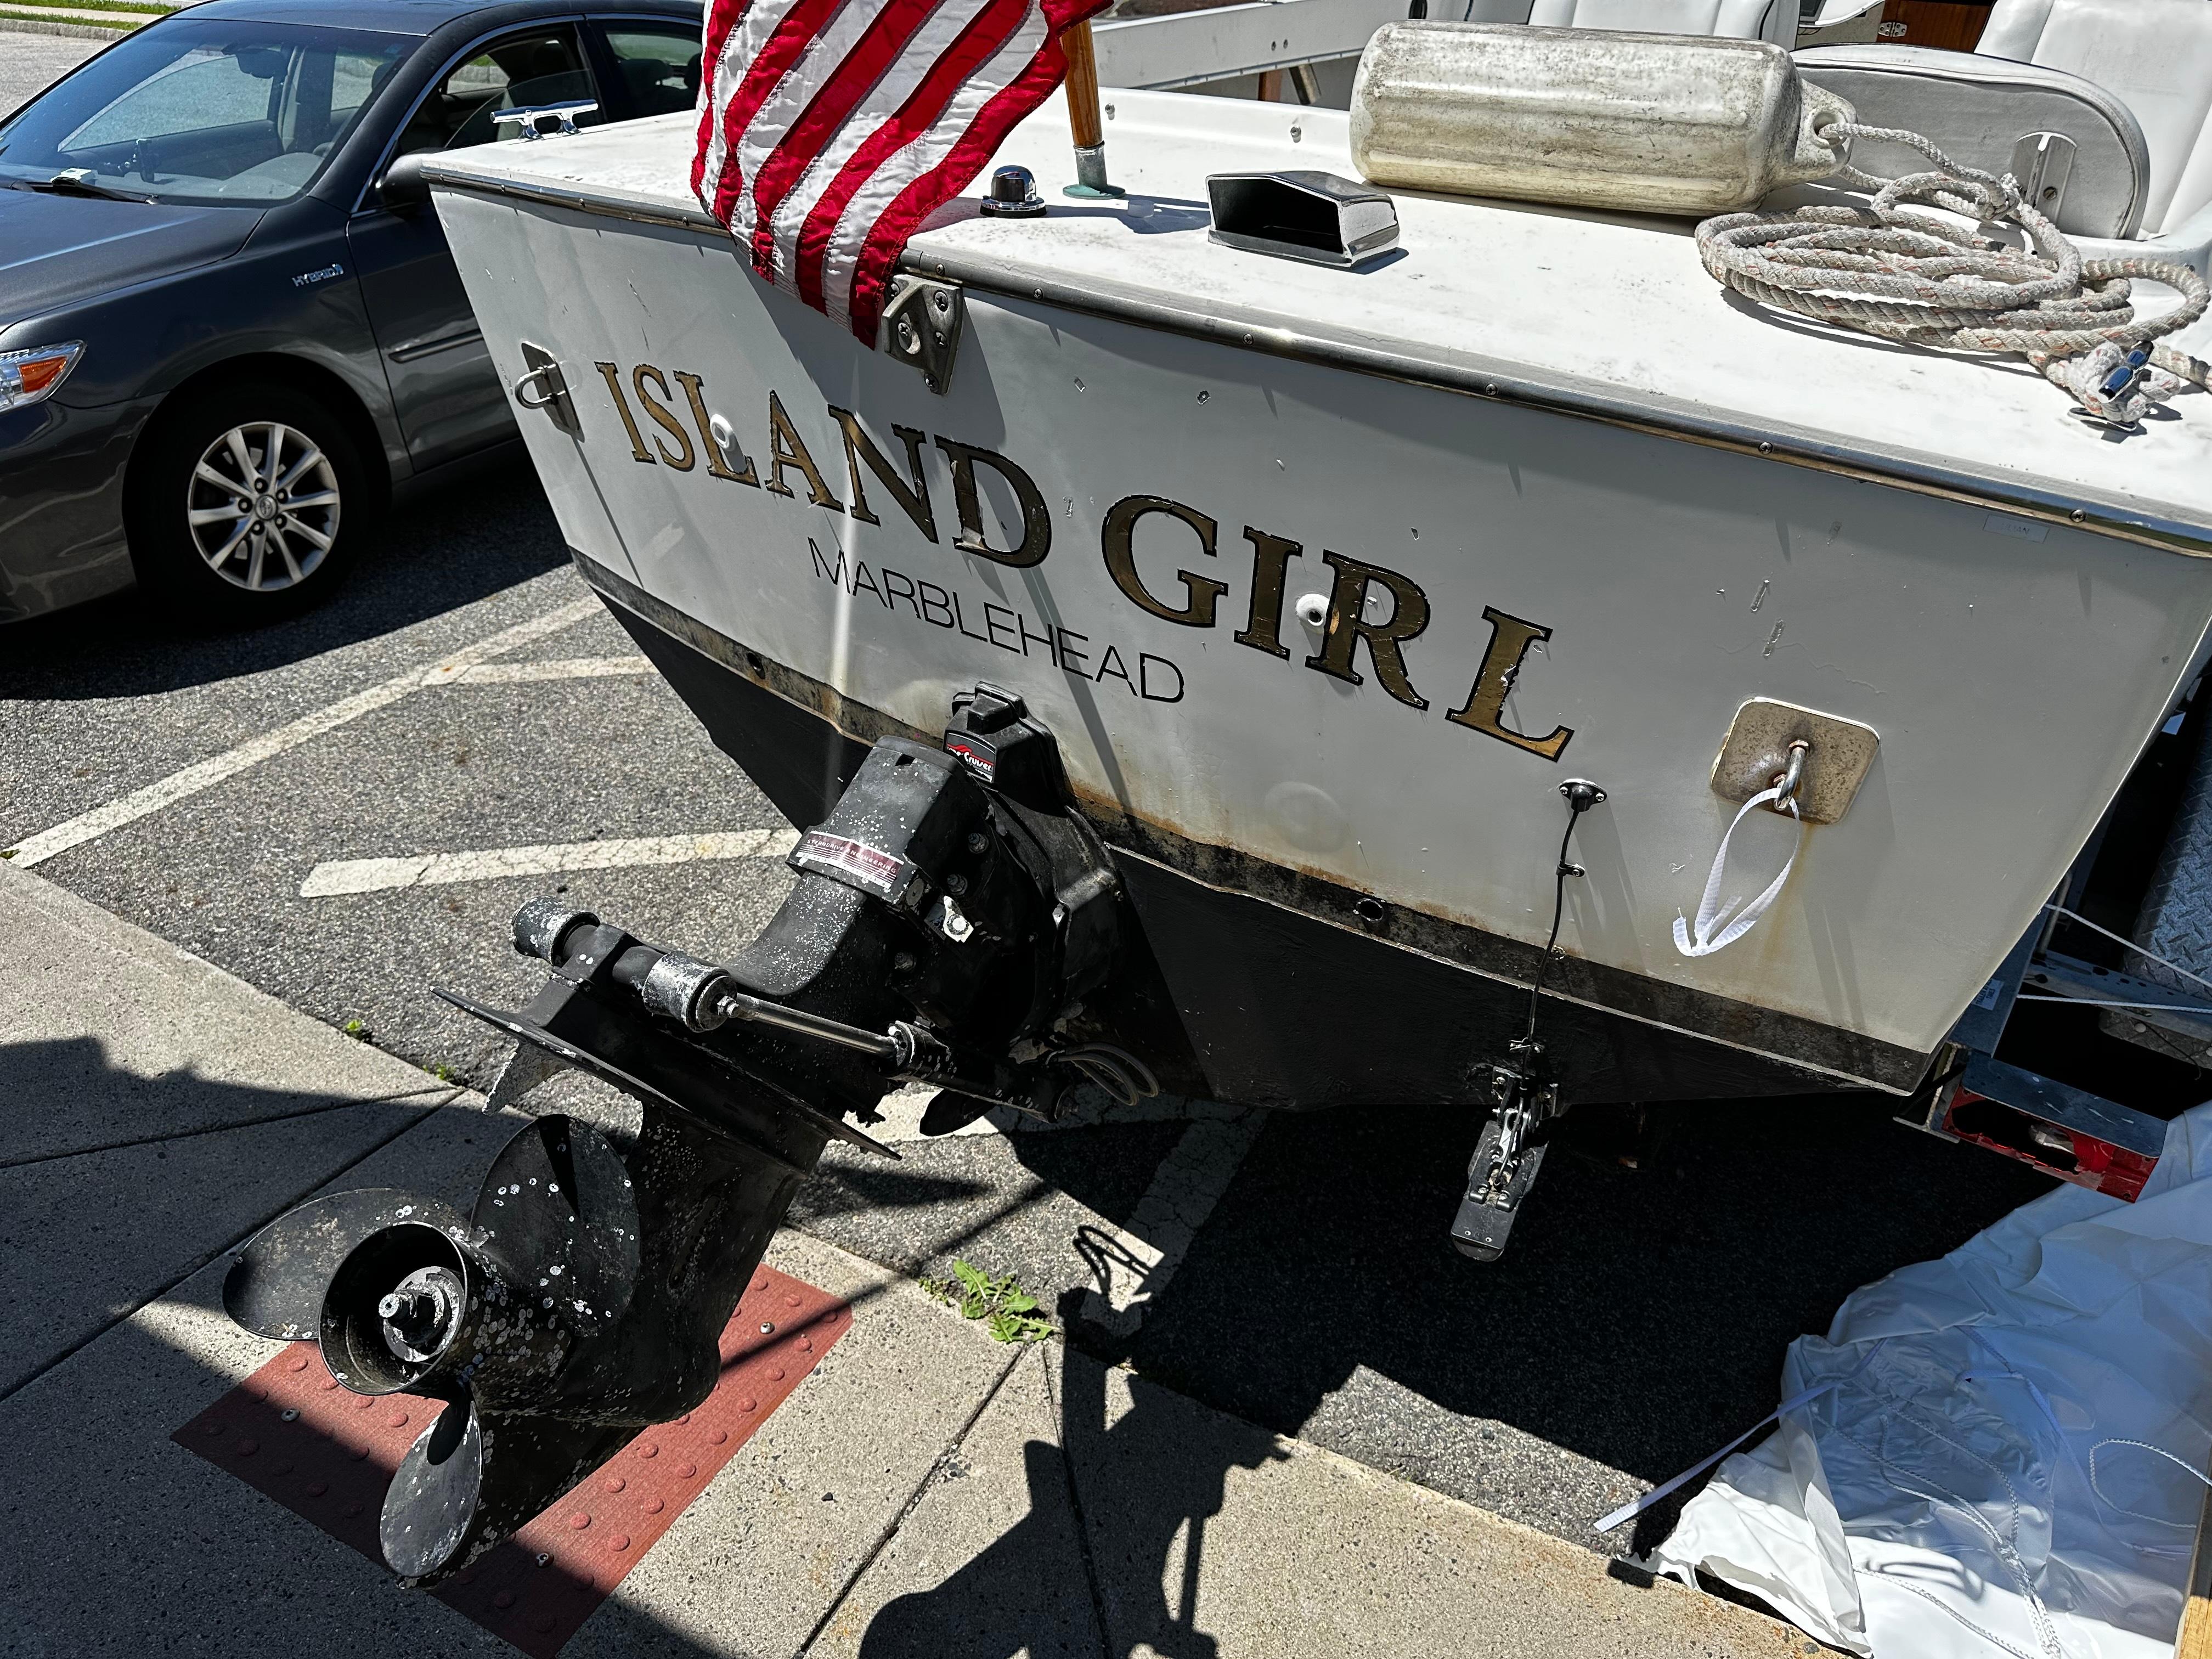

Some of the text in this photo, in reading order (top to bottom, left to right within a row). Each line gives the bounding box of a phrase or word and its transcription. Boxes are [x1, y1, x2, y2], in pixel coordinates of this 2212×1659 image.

[292, 267, 339, 286] HYBRID
[594, 360, 1575, 763] ISLAND GIRL
[807, 536, 1185, 703] MARBLEHEAD
[807, 839, 845, 851] STERNDRIVE
[847, 847, 897, 873] ENGINEERING
